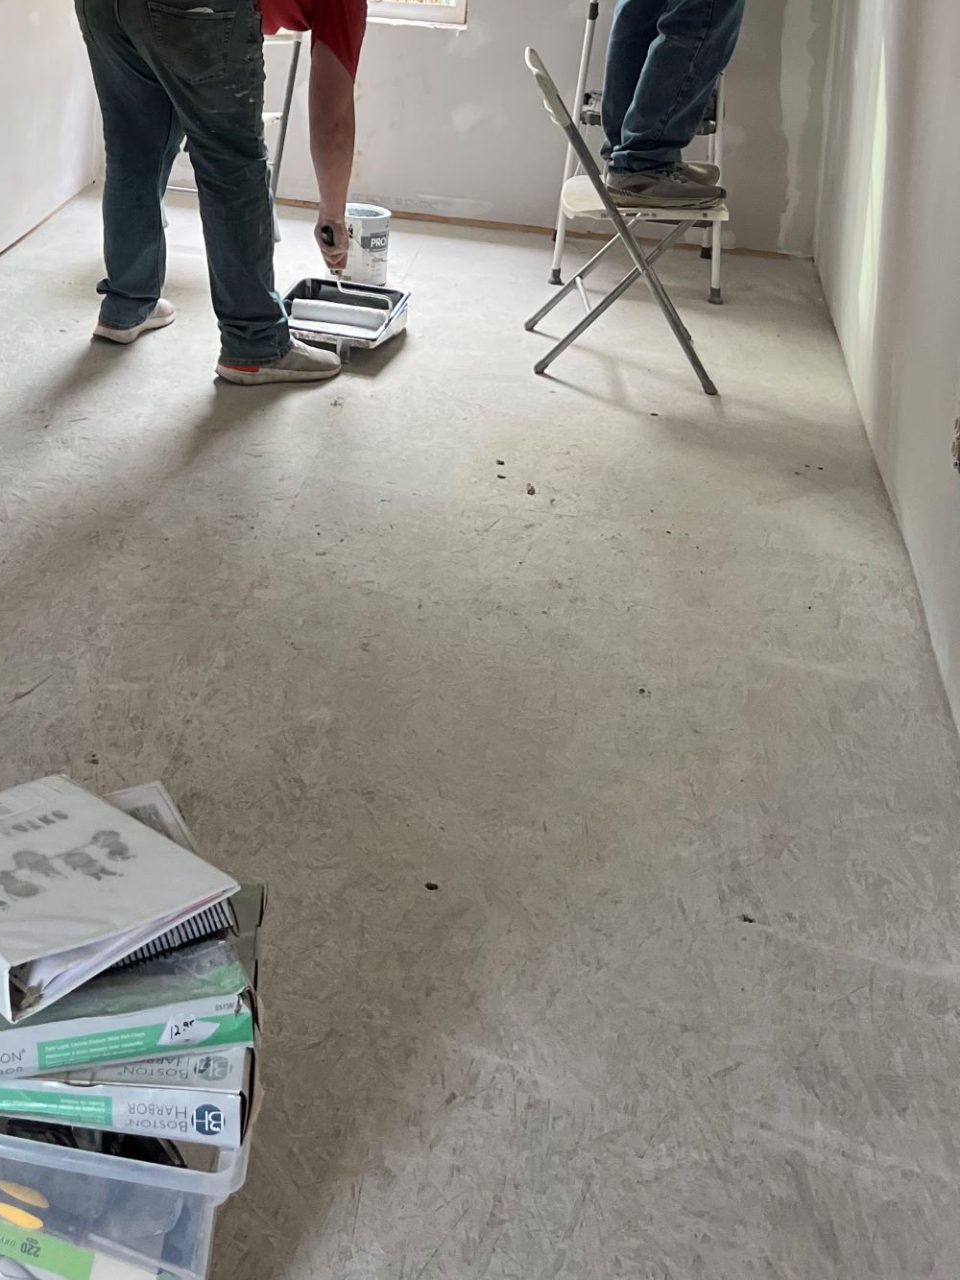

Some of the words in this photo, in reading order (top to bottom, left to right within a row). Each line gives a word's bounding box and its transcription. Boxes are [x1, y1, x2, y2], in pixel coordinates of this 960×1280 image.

[127, 1103, 188, 1119] HARBOR
[129, 1119, 189, 1133] BOSTON
[20, 1241, 41, 1258] 220
